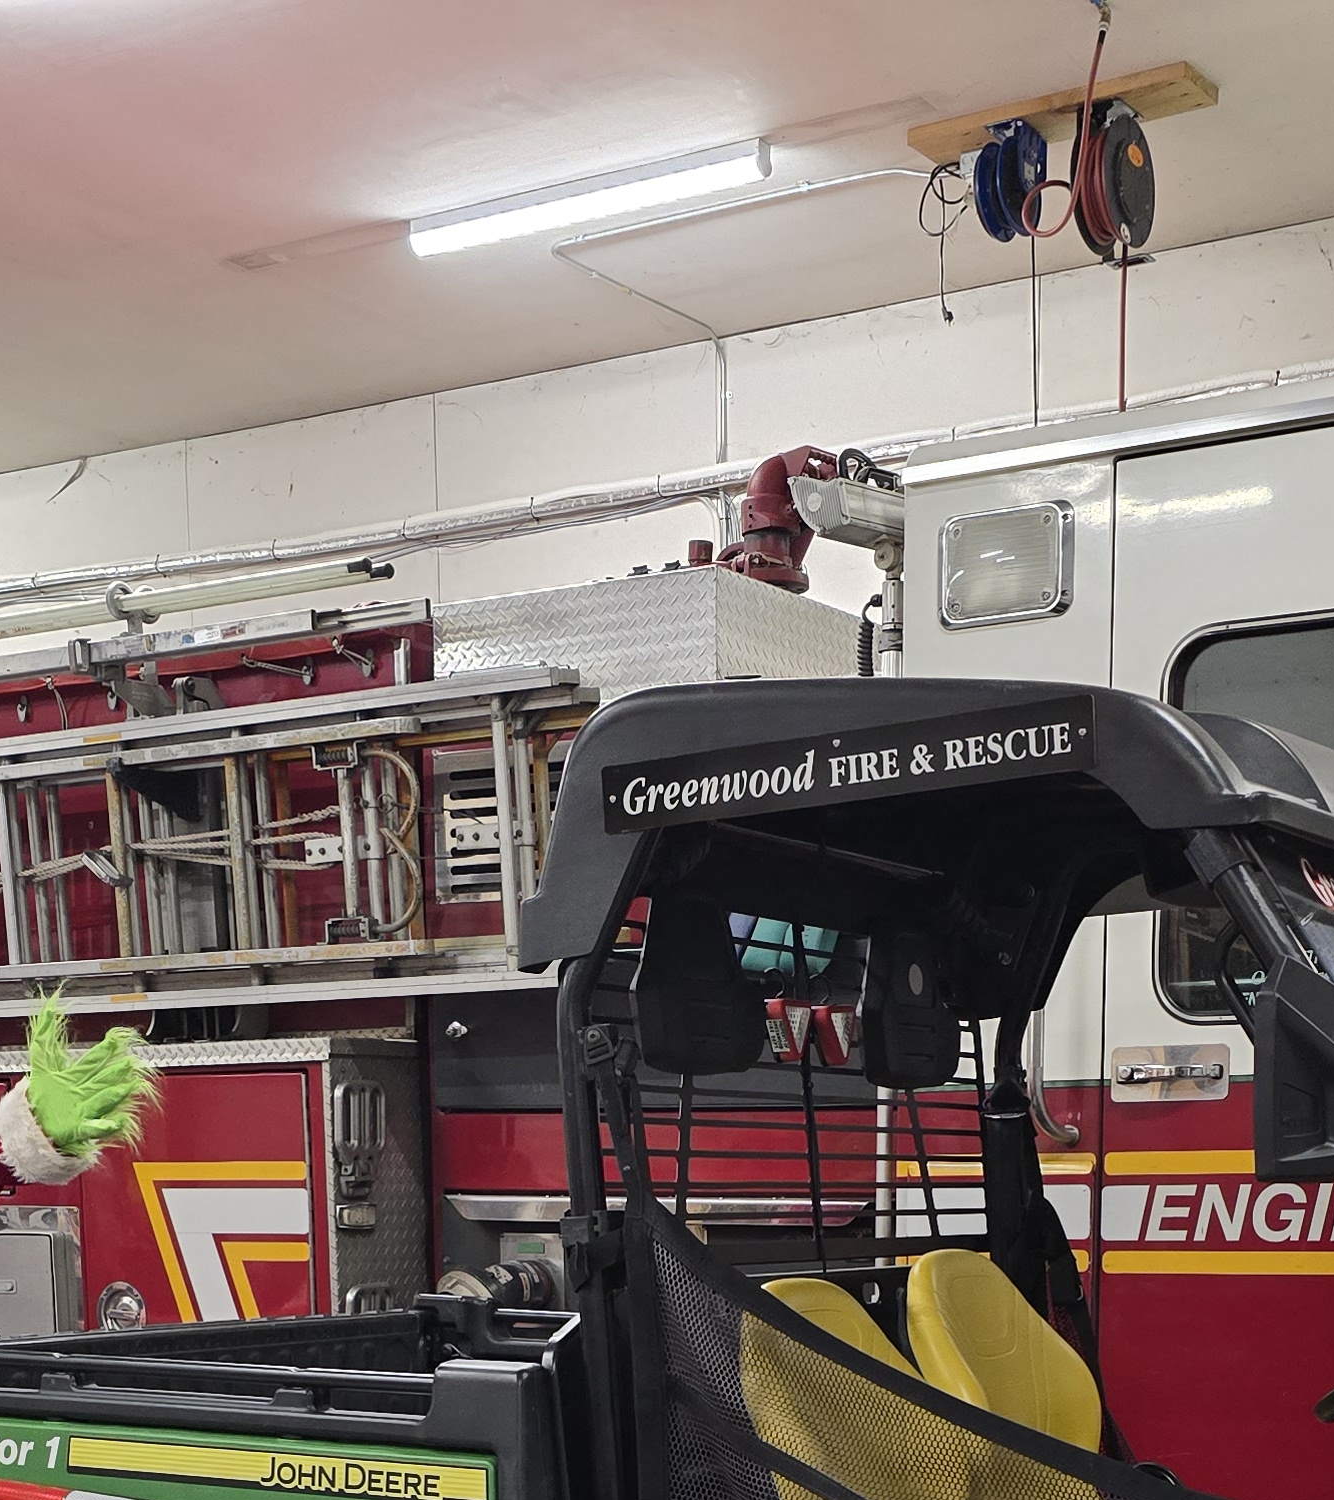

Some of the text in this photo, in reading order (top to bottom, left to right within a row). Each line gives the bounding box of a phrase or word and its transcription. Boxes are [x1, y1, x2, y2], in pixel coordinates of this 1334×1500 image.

[622, 722, 1072, 816] Greenwood FIRE & RESCUE
[44, 1436, 61, 1470] 1
[261, 1456, 441, 1498] JOHN DEERE
